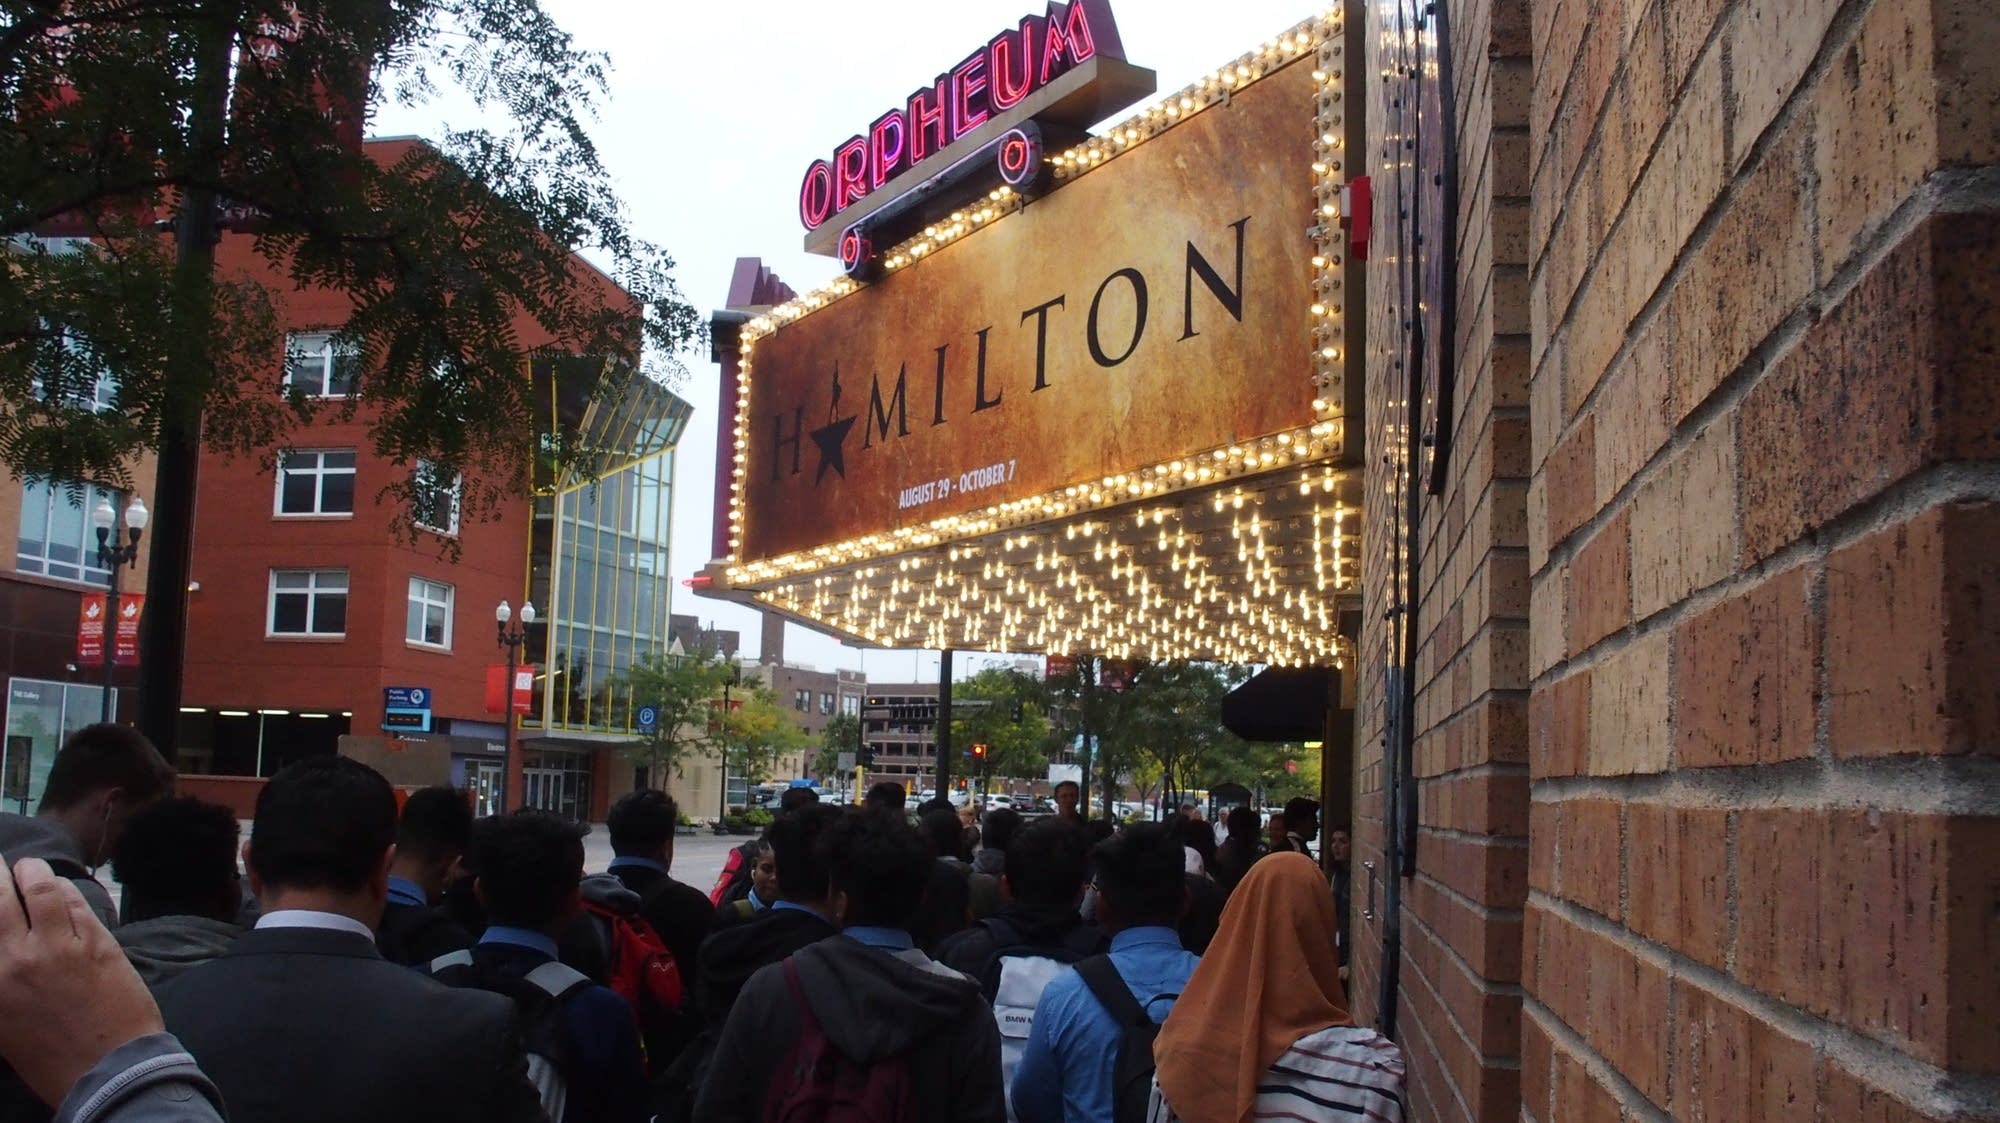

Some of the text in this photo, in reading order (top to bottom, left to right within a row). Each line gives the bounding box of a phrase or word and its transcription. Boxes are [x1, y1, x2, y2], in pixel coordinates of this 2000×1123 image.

[800, 0, 1097, 231] ORPHEUM
[771, 216, 1252, 487] HMILTON
[899, 481, 935, 509] AUGUST
[938, 478, 950, 499] 29
[960, 463, 1005, 493] OCTOBER
[1008, 459, 1016, 481] 7
[1005, 1015, 1026, 1023] BMW
